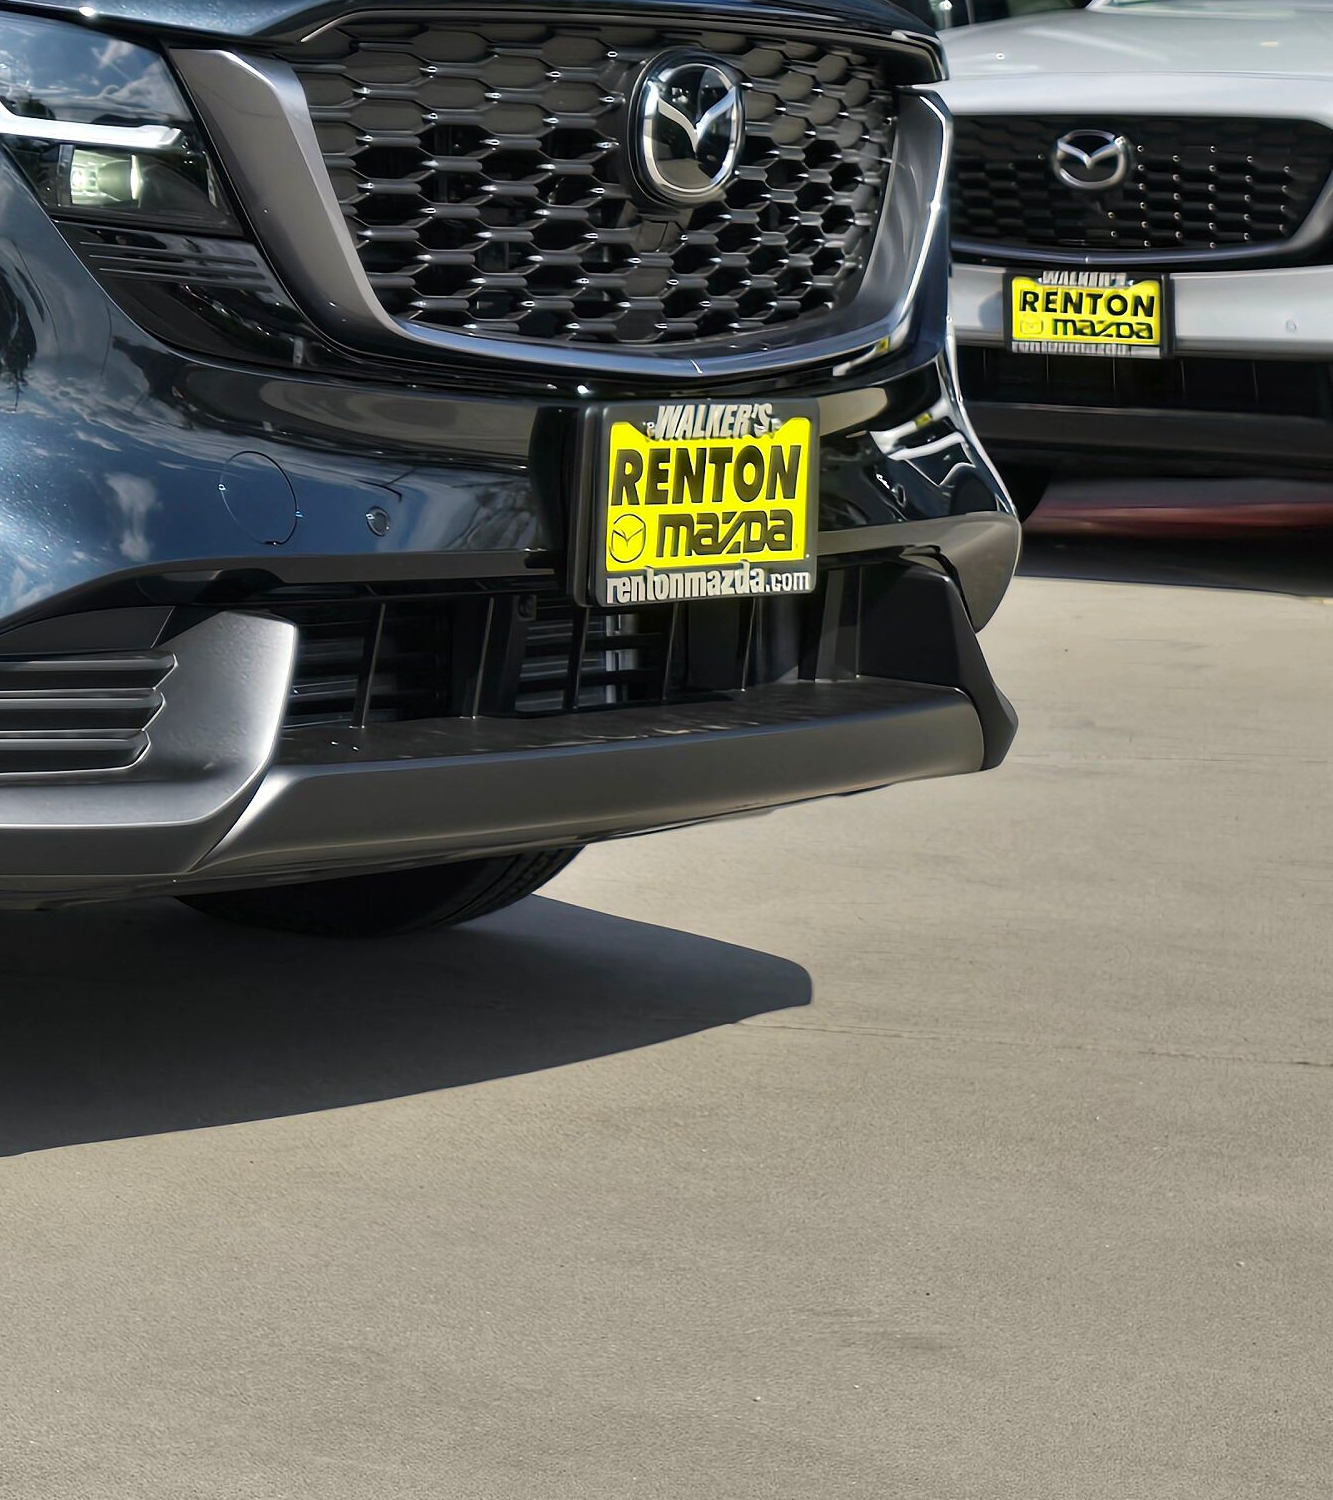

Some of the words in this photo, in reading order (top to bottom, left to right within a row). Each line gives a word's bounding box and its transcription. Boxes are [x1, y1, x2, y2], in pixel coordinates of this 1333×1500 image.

[1019, 290, 1156, 318] RENTON
[1052, 317, 1155, 341] mazda
[653, 403, 774, 441] WALKER'S
[610, 444, 803, 507] RENTON
[655, 508, 794, 559] mazda
[605, 558, 811, 605] rentonmazda.com
